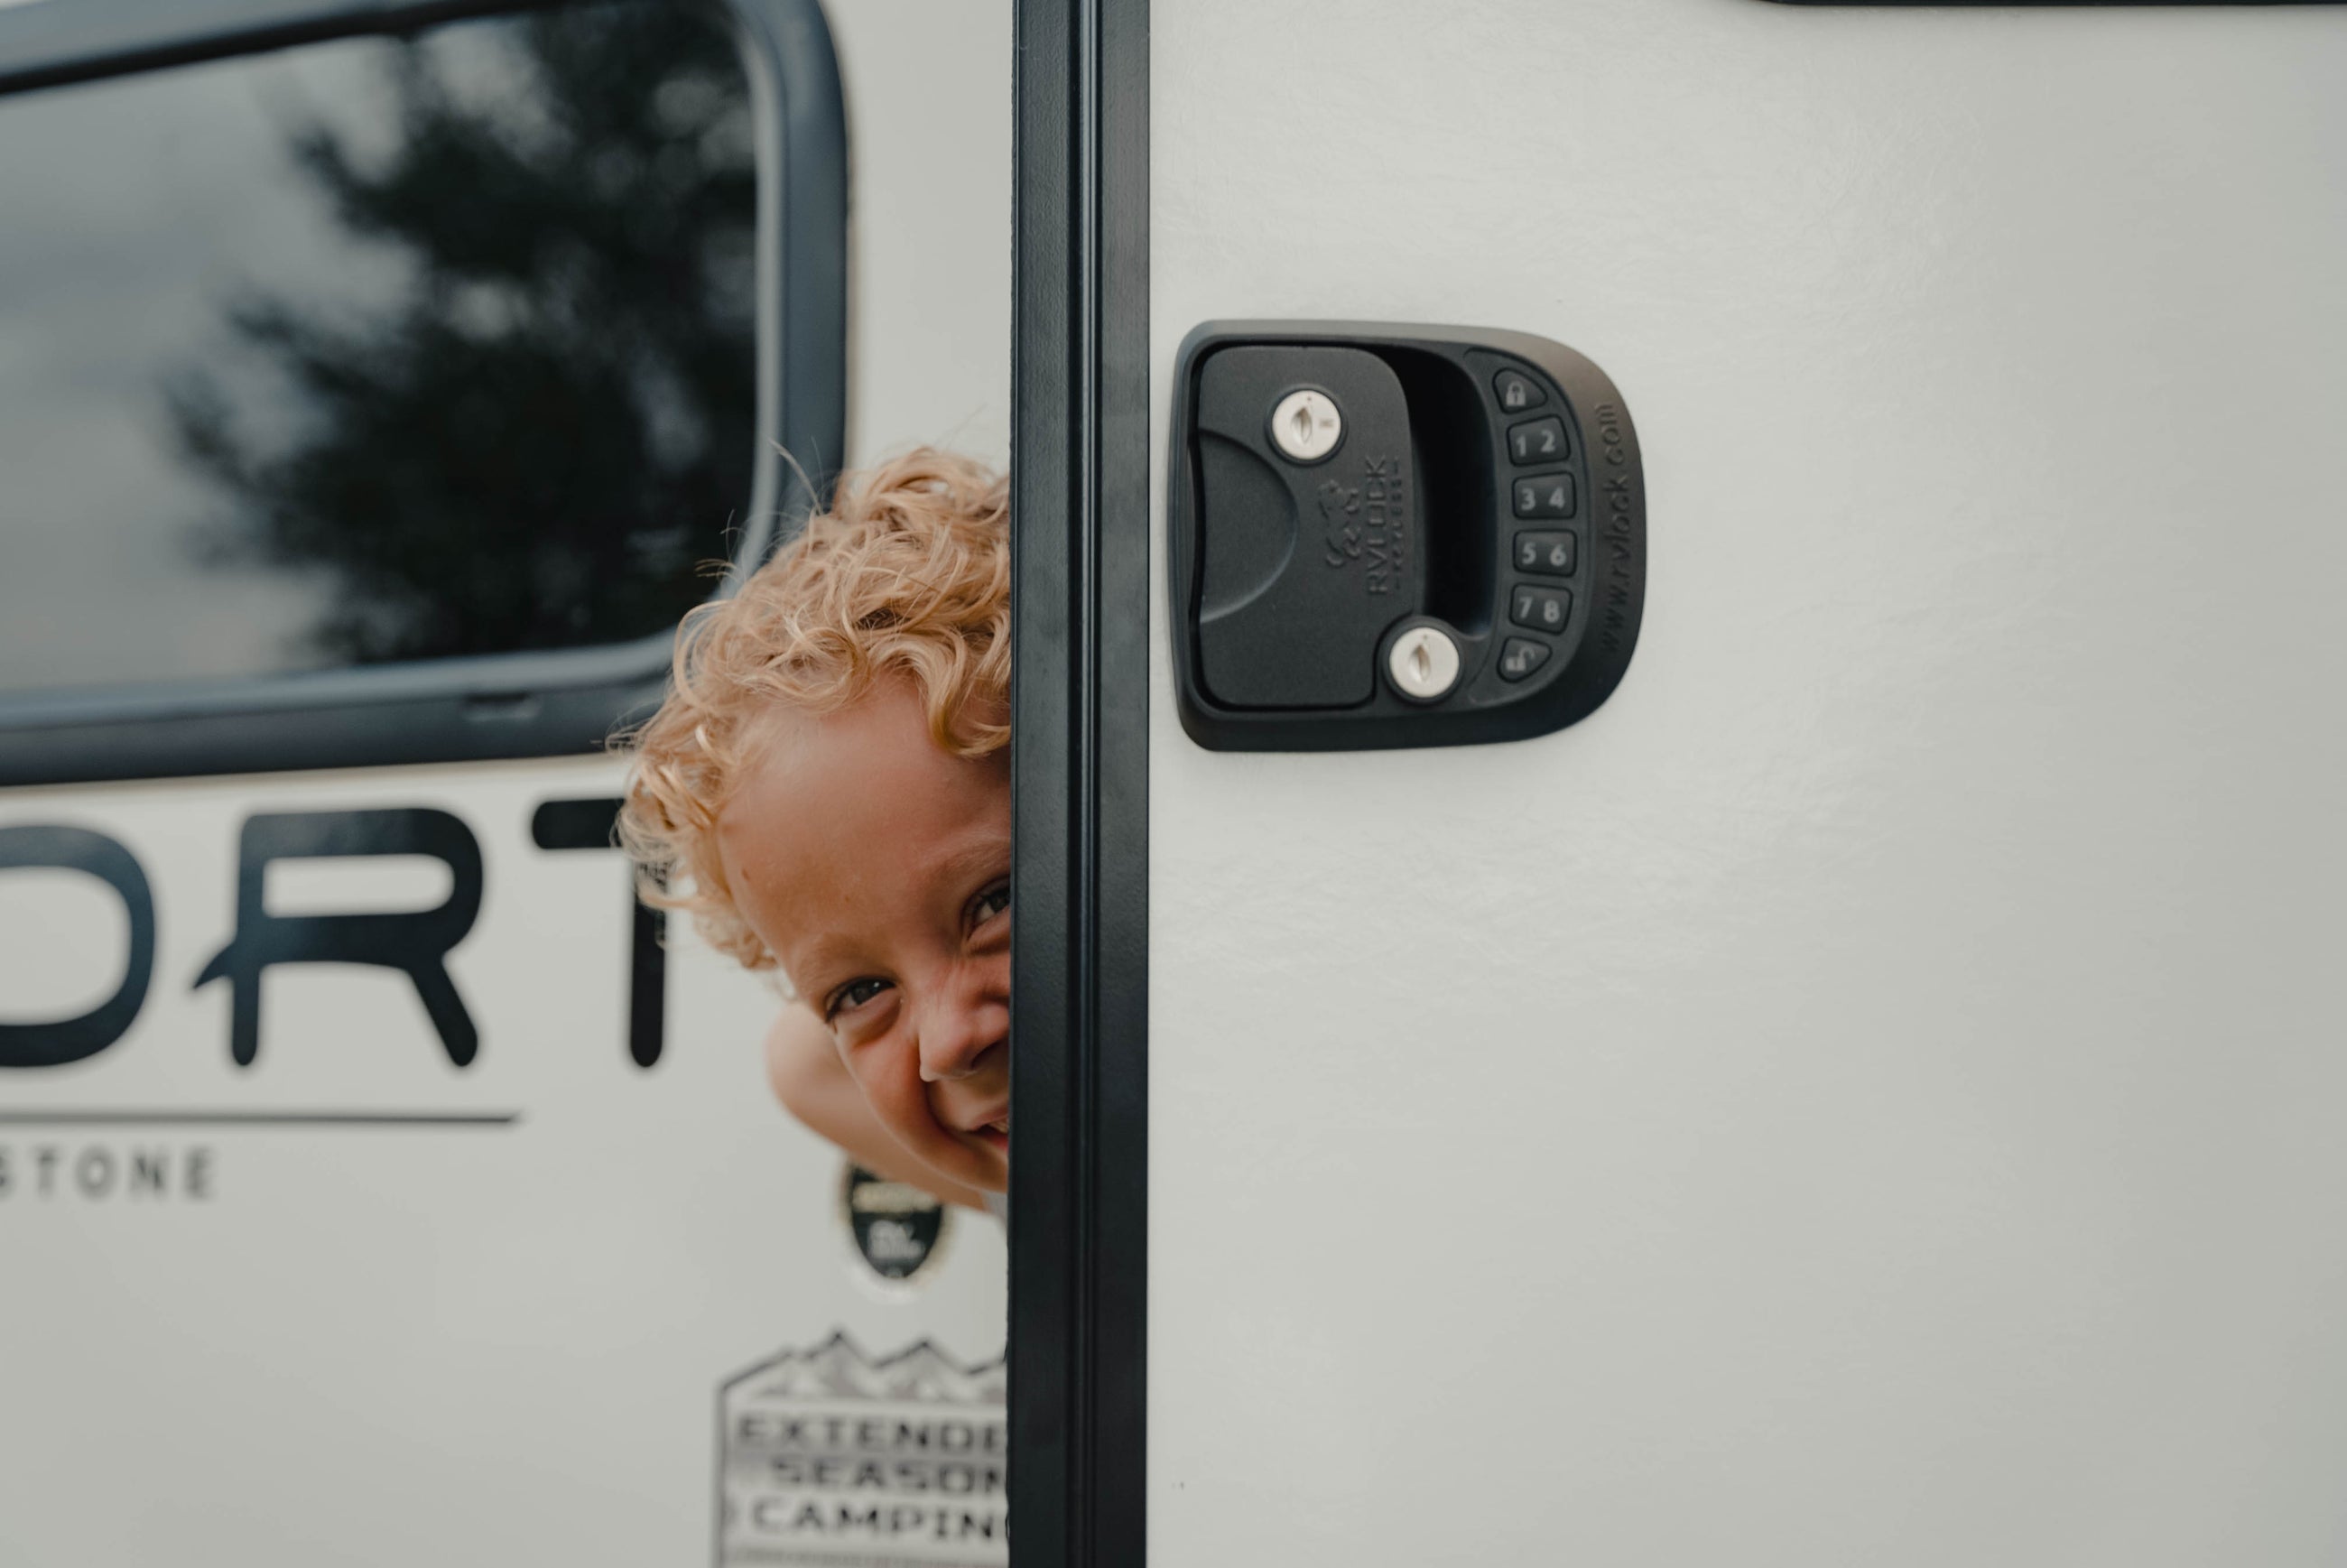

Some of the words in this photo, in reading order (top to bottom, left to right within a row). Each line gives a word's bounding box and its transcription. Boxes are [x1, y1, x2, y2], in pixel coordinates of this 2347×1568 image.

[1517, 436, 1526, 457] 1
[1541, 429, 1555, 452] 2
[1521, 487, 1535, 511] 3
[1549, 486, 1565, 509] 4
[1365, 454, 1388, 595] RVLOCK
[1522, 543, 1536, 565] 5
[1549, 543, 1567, 566] 6
[1519, 597, 1533, 619] 7
[1543, 599, 1560, 623] 8
